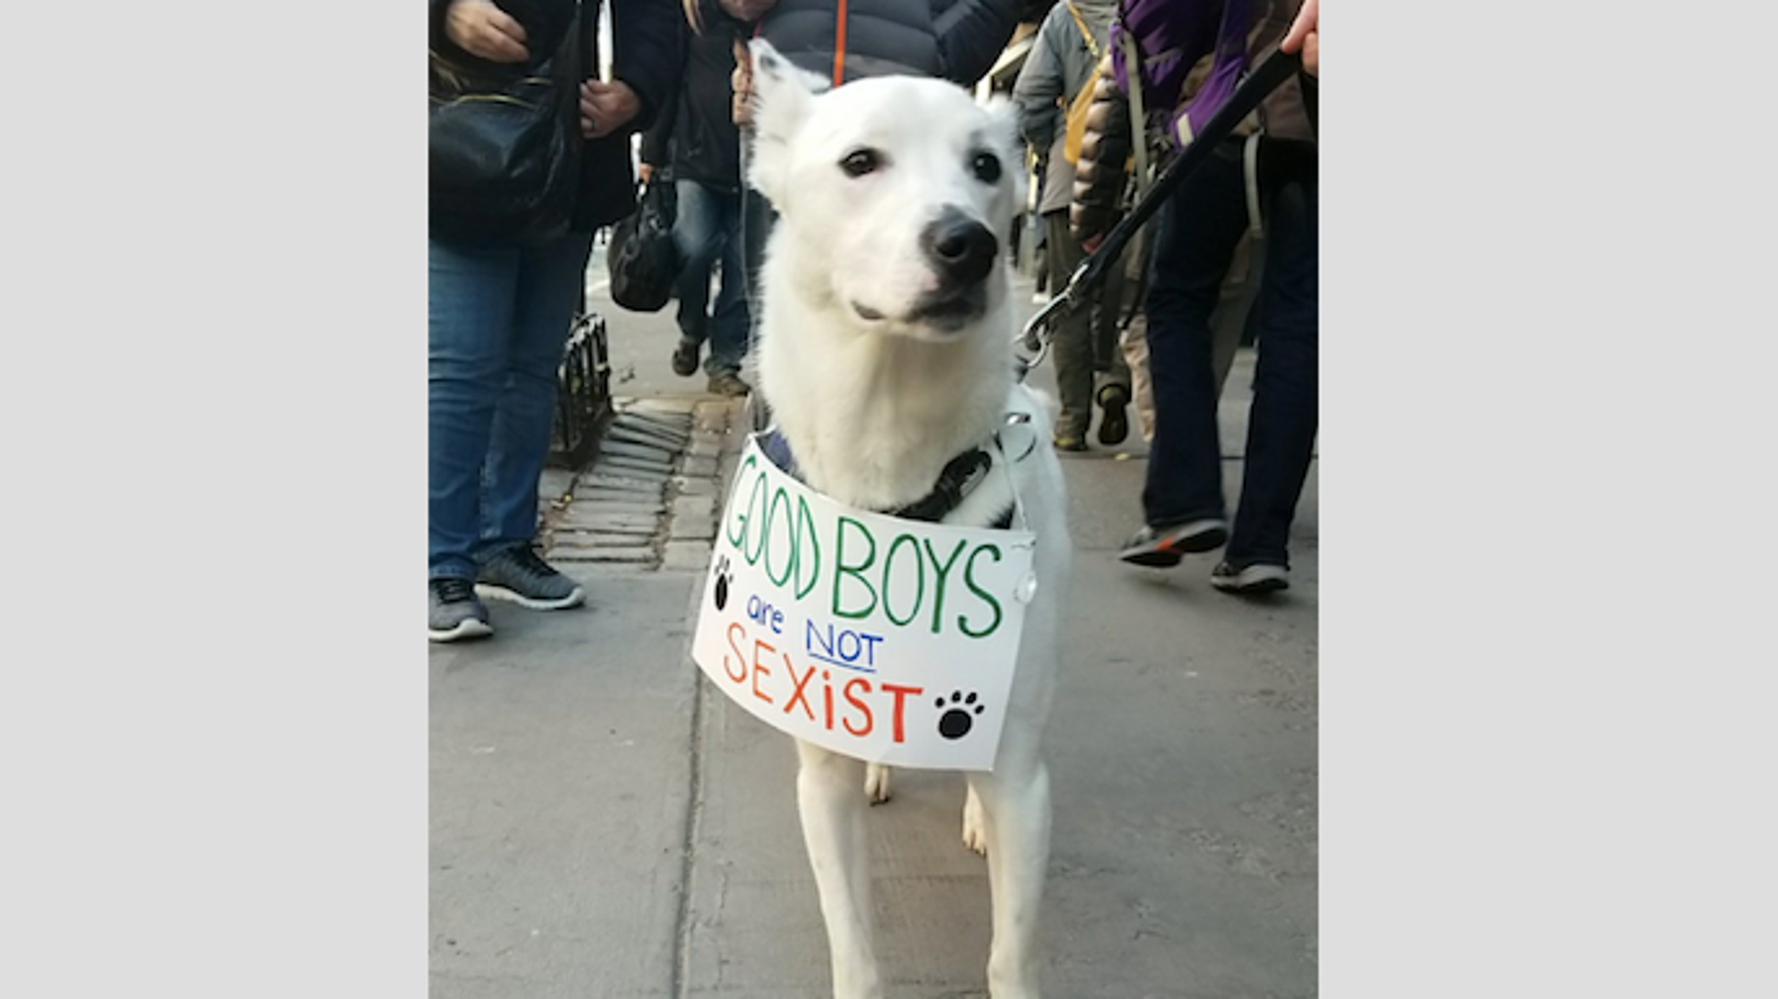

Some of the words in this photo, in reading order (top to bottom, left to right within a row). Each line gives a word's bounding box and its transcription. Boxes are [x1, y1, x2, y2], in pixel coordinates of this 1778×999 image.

[726, 454, 820, 601] GOOD
[832, 515, 1003, 638] BOYS
[747, 594, 785, 634] are
[806, 619, 884, 666] NOT
